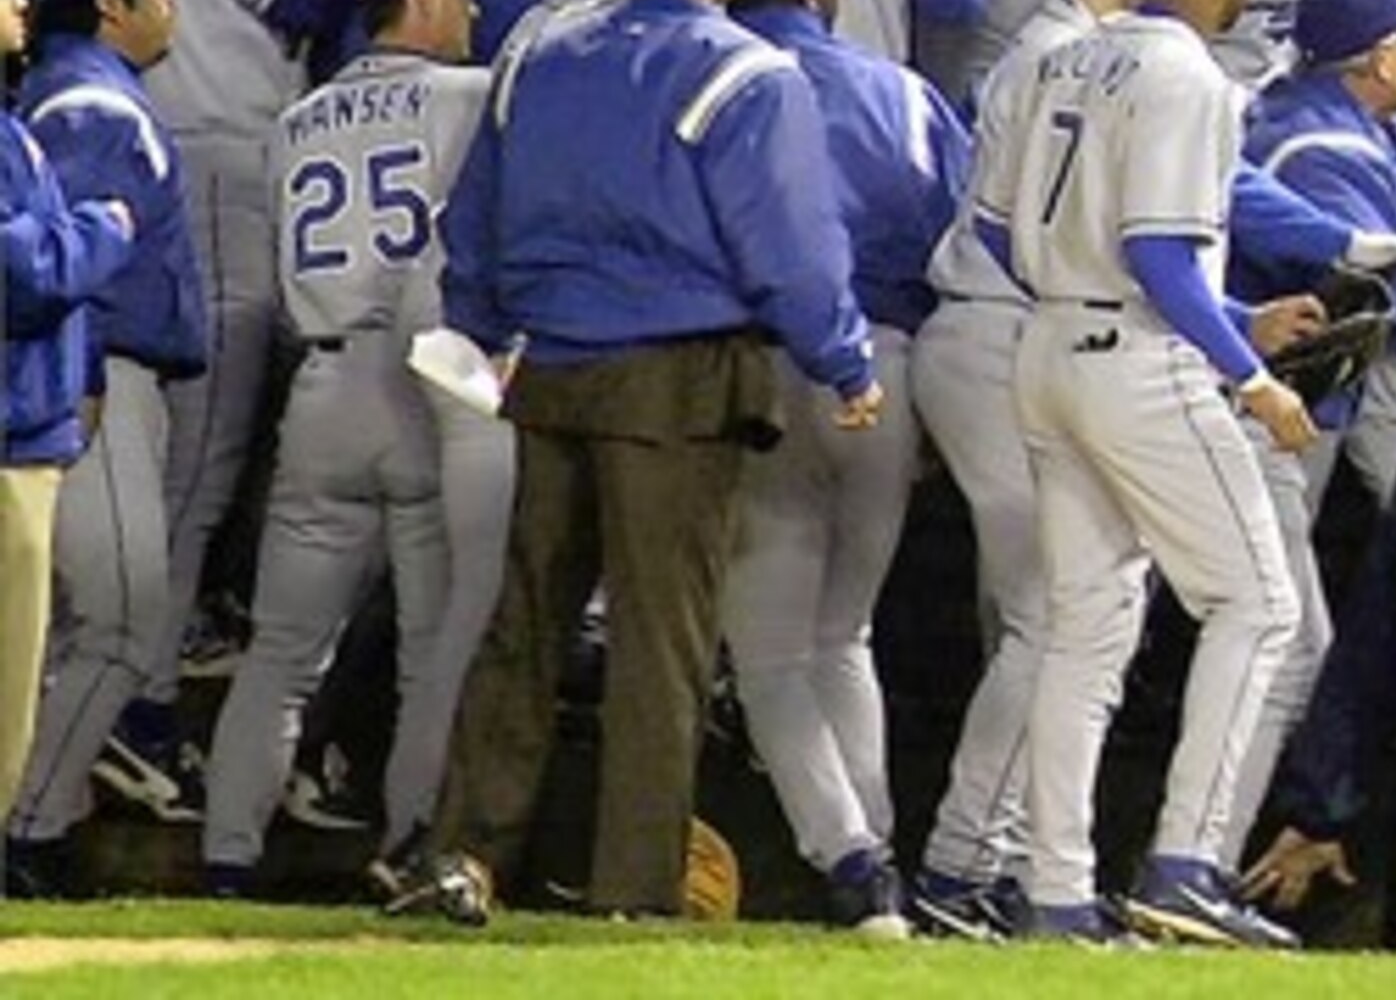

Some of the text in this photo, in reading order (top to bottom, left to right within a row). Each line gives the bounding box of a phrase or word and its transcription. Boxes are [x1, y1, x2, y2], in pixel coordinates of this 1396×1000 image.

[287, 82, 431, 145] HANSEN
[1042, 110, 1084, 224] 7
[291, 146, 430, 273] 25
